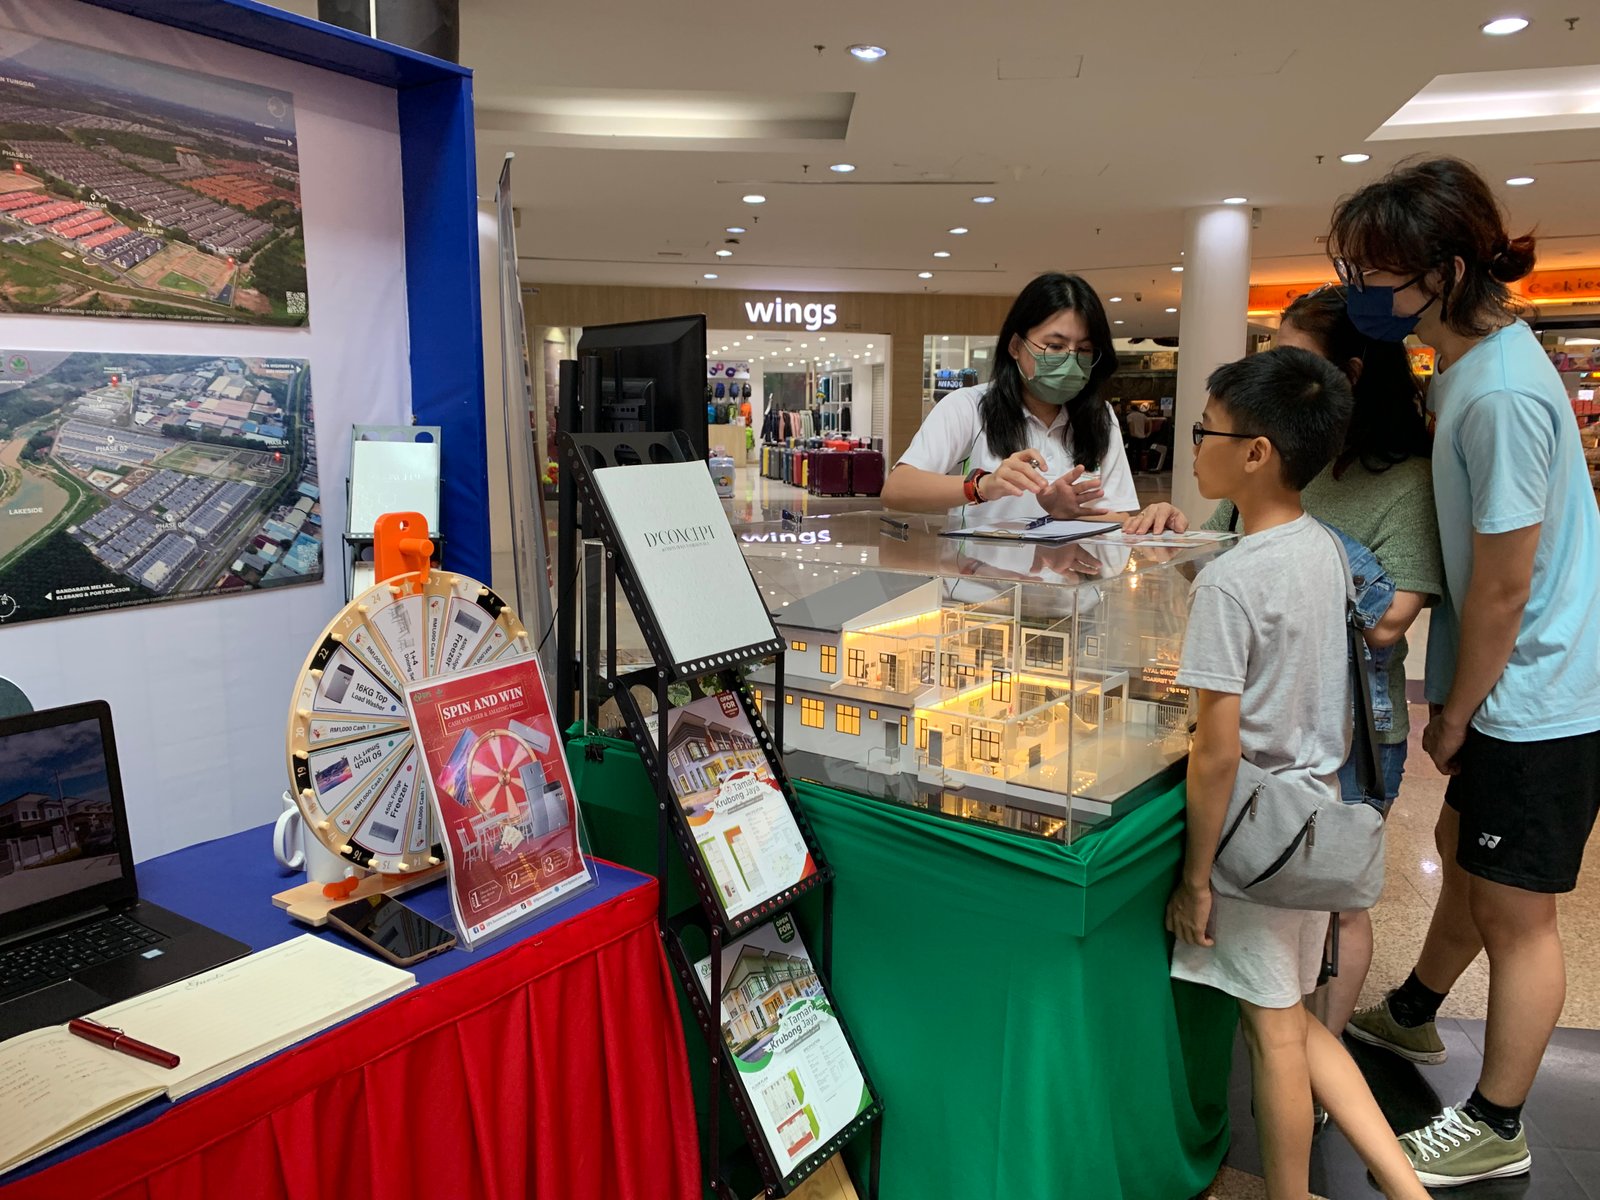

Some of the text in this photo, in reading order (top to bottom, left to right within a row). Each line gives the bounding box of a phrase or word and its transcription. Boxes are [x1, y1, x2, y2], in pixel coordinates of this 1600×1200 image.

[744, 296, 837, 331] wings
[9, 507, 43, 515] LAKESIDE
[741, 529, 831, 545] wings
[56, 585, 91, 594] BANDARAYA
[435, 577, 440, 586] 2
[90, 589, 105, 597] PORT
[105, 586, 131, 595] DICKSON
[372, 593, 381, 604] 24
[342, 616, 353, 628] 23
[318, 647, 330, 660] 22
[355, 682, 388, 704] 16KG Top
[351, 693, 385, 711] Load Washer
[442, 686, 523, 720] SPIN AND WIN
[722, 700, 736, 710] FOR
[296, 727, 305, 738] 20
[297, 766, 307, 778] 19
[733, 776, 757, 792] Taman
[390, 783, 409, 819] Freezer
[714, 792, 745, 809] Krubong
[745, 784, 761, 797] Jaya
[353, 851, 363, 861] 16
[545, 856, 554, 873] 3
[511, 873, 521, 889] 2
[474, 892, 482, 909] 1
[778, 923, 792, 935] FOR
[788, 1004, 814, 1026] Taman
[769, 1025, 803, 1051] Krubong
[802, 1014, 818, 1029] Jaya
